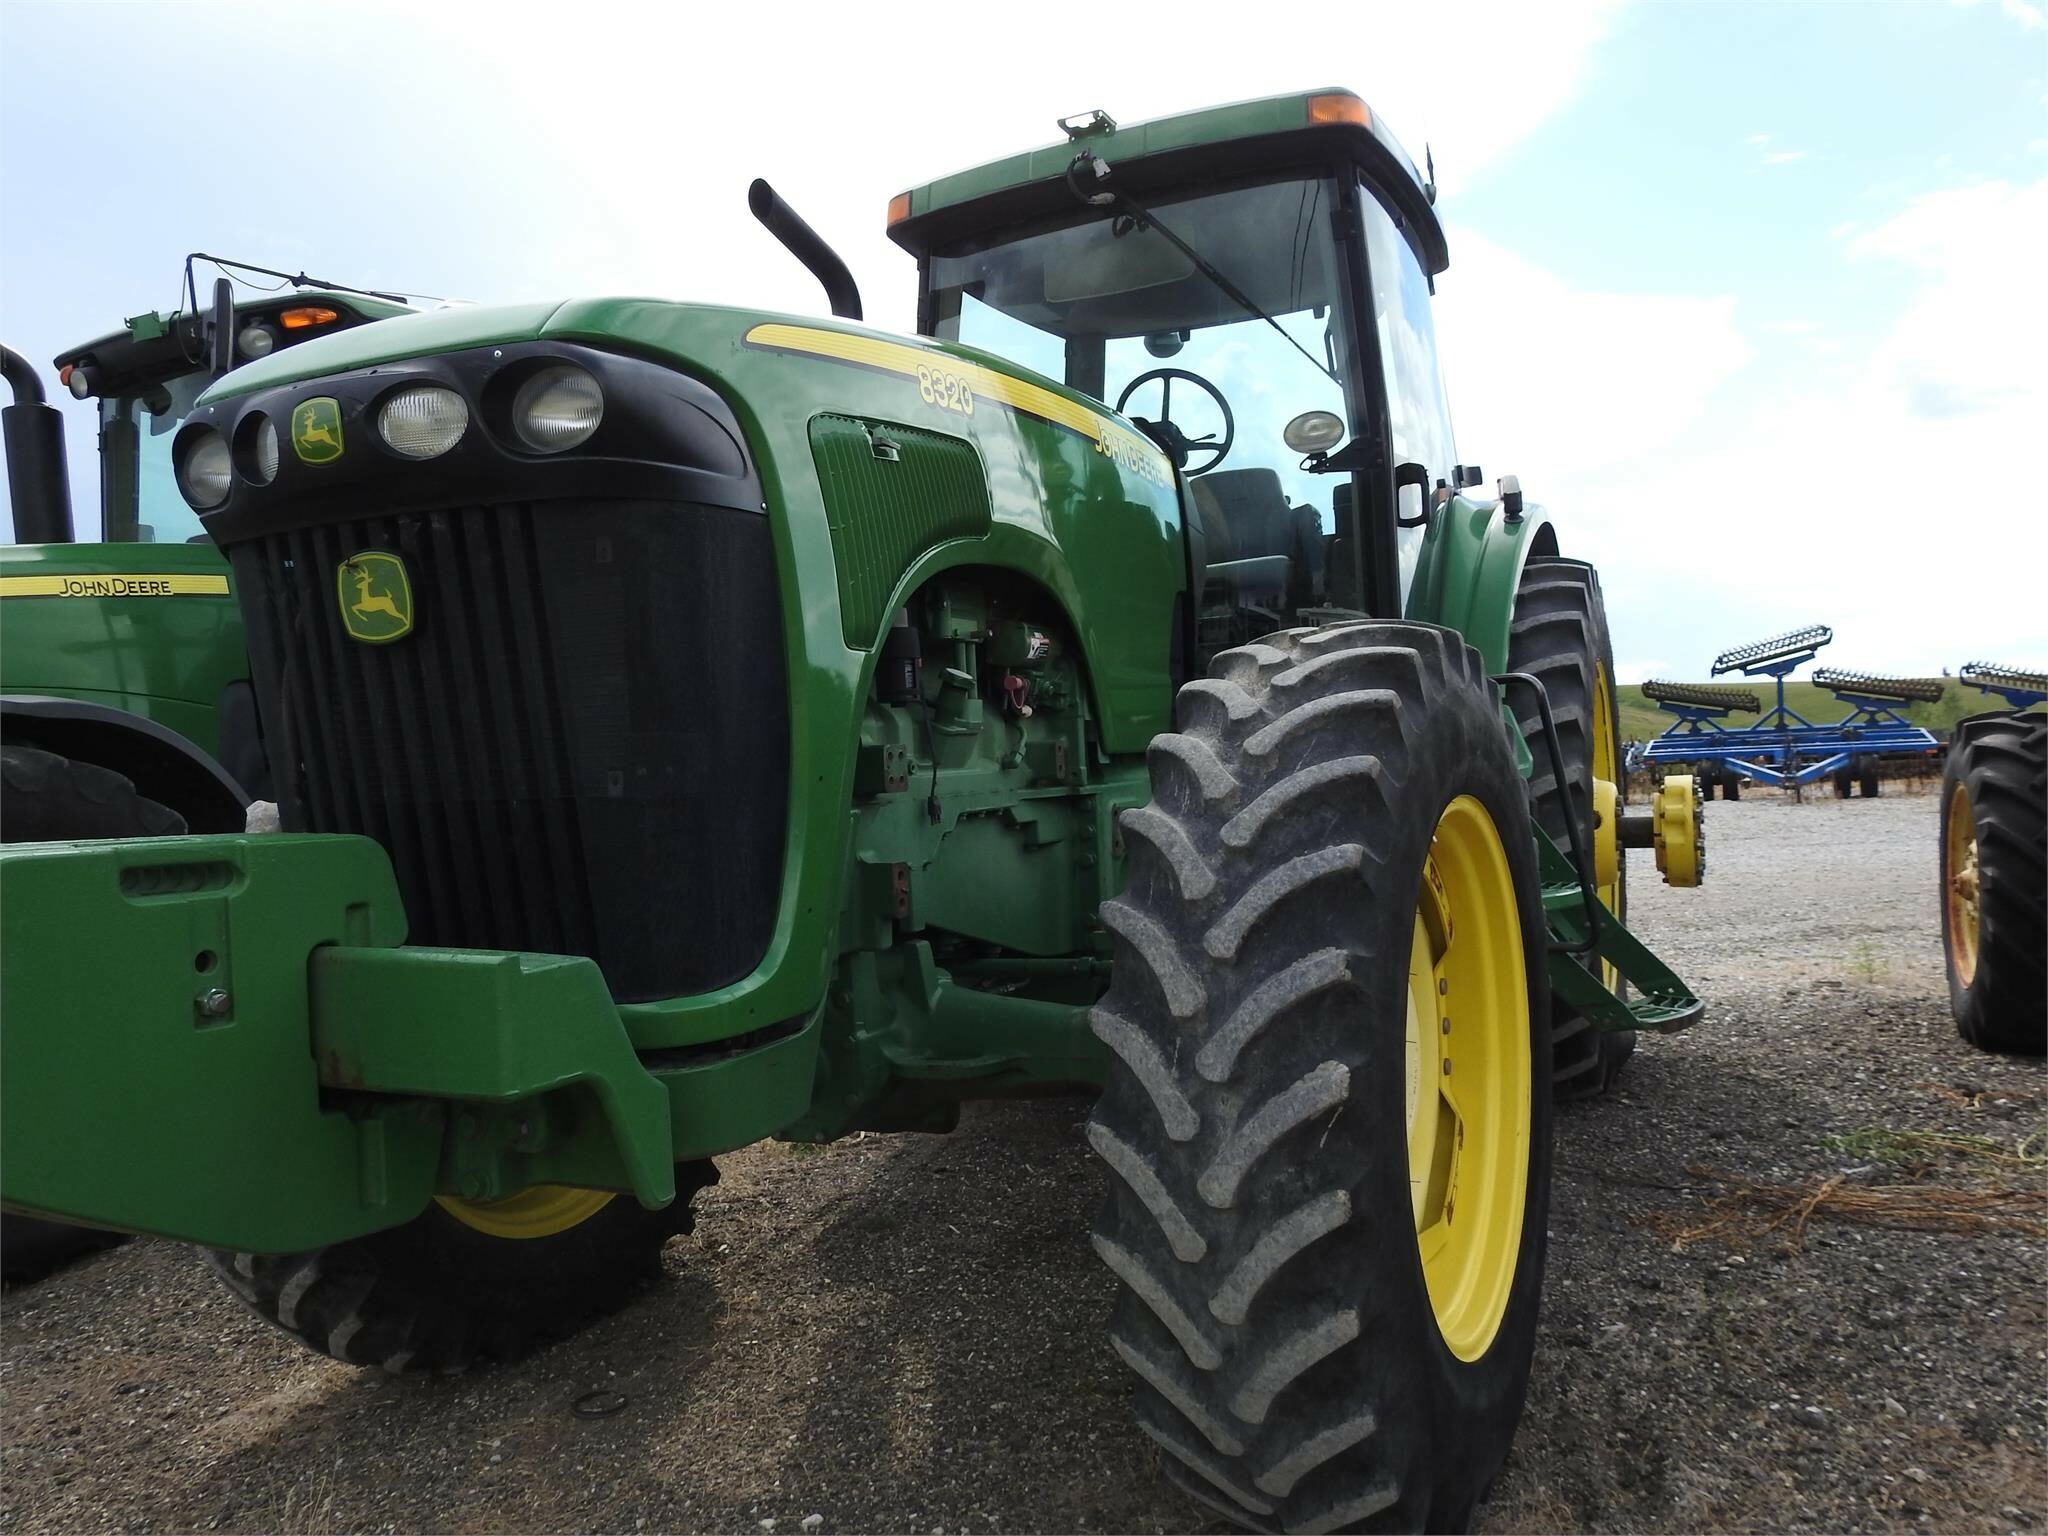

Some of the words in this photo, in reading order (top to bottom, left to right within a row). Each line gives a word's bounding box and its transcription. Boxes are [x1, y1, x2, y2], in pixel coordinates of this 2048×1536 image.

[917, 364, 975, 416] 8320
[1095, 420, 1131, 468] JOHN
[59, 578, 111, 596] JOHN
[112, 578, 173, 596] DEERE
